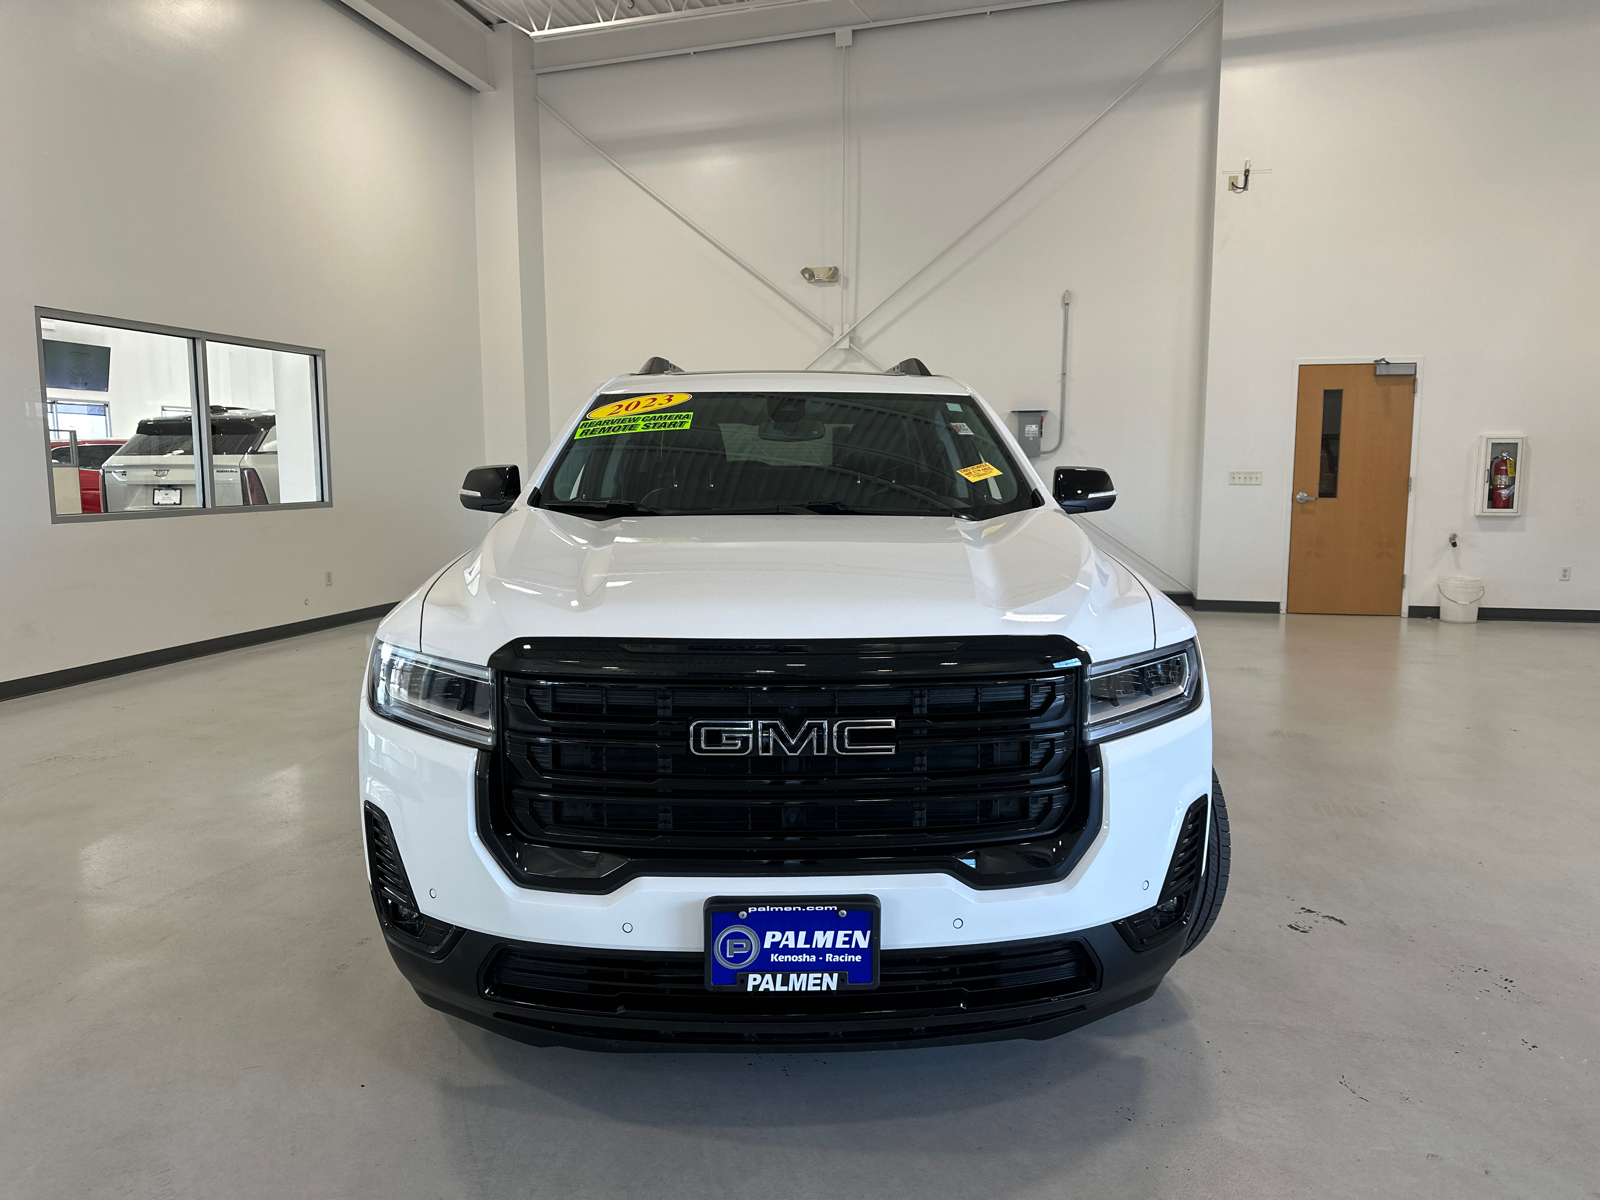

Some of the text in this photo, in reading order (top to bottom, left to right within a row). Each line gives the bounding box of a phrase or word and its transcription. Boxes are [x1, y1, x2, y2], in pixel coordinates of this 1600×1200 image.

[608, 394, 674, 416] 2023
[579, 420, 688, 437] REMOTE START
[580, 413, 691, 429] REARVIEW CAMERA
[689, 719, 896, 756] GMC
[748, 905, 838, 913] palmen.com
[763, 930, 871, 949] PALMEN
[770, 953, 816, 962] Kenosha
[825, 953, 862, 962] Racine
[747, 972, 839, 992] PALMEN
